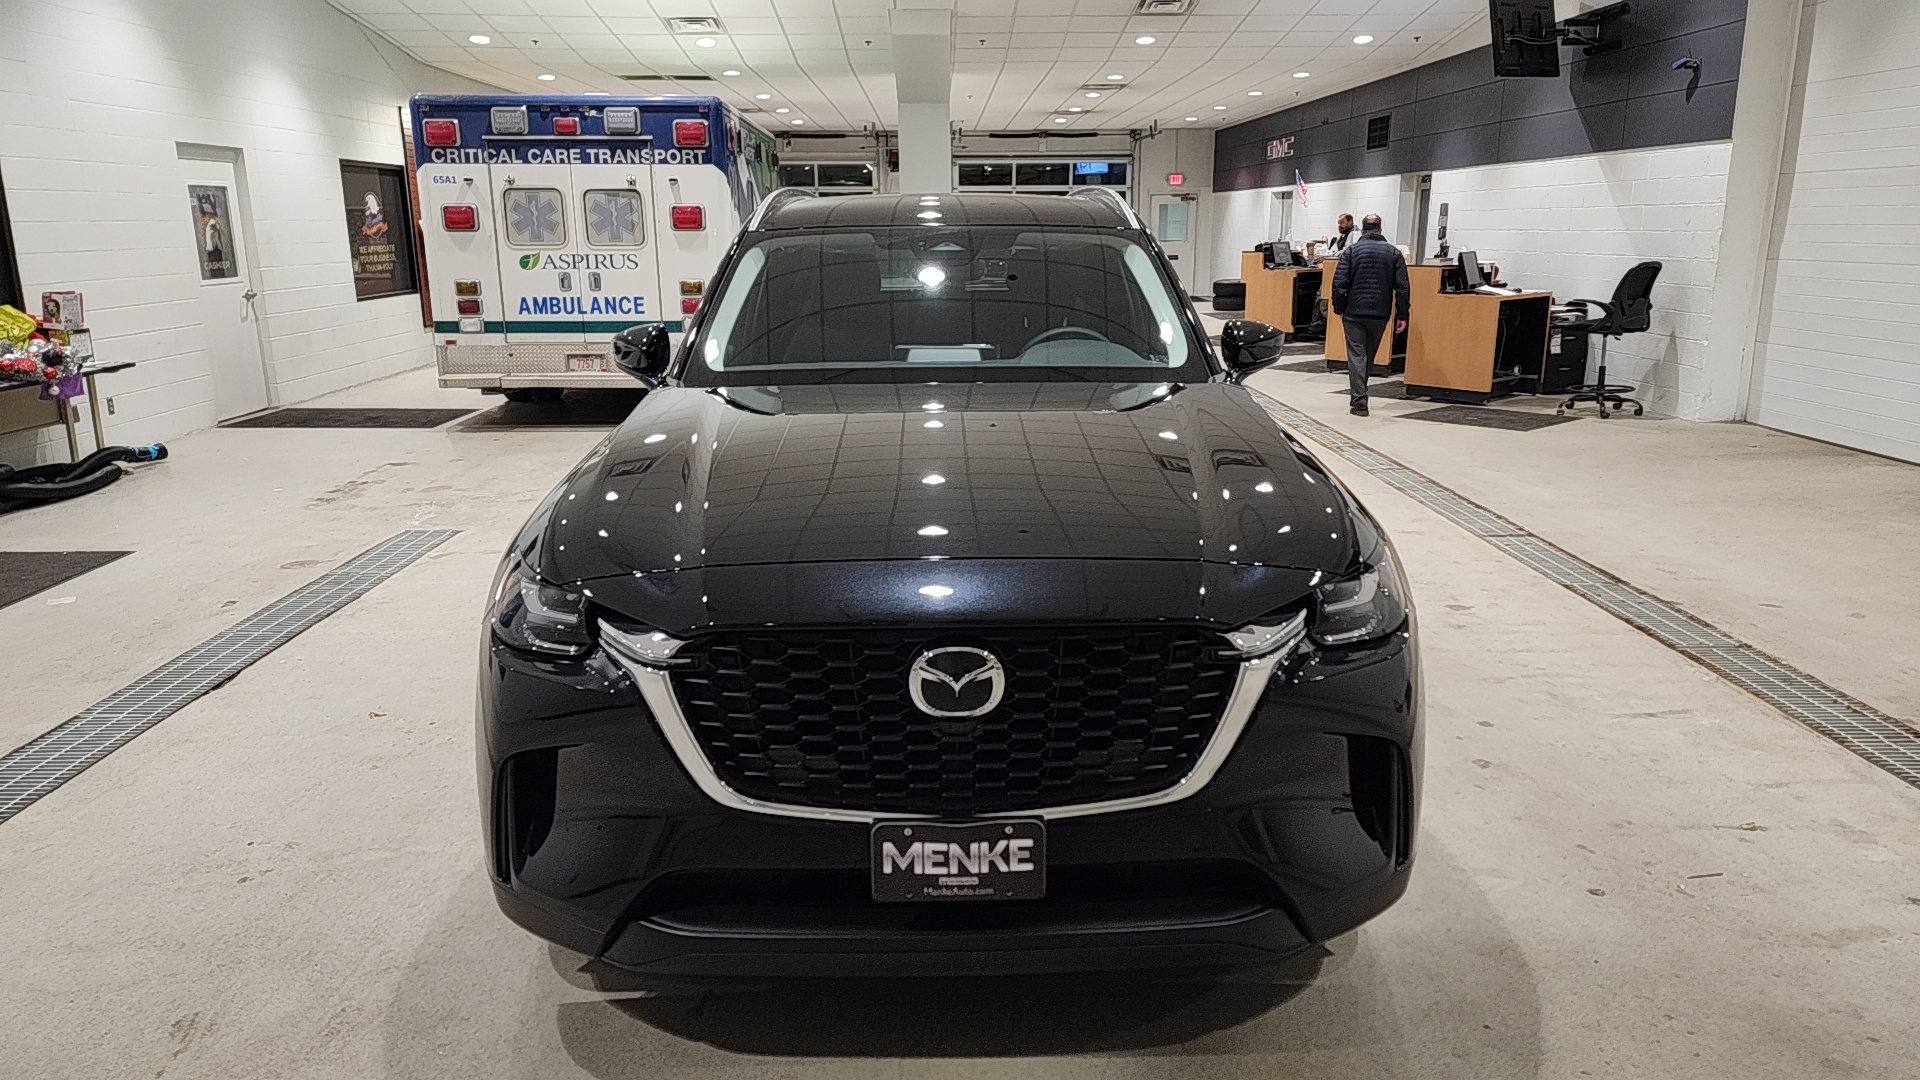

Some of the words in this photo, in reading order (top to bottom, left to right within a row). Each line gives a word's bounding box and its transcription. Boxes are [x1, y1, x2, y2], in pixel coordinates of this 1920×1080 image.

[1266, 136, 1294, 160] GMC
[431, 149, 523, 164] CRITICAL
[527, 149, 582, 164] CARE
[586, 149, 706, 164] TRANSPORT
[433, 175, 458, 185] 65A1
[204, 260, 231, 270] CASHIER
[541, 253, 639, 270] ASPIRUS
[518, 296, 646, 315] AMBULANCE
[577, 358, 594, 370] 7757
[882, 838, 1034, 875] MENKE
